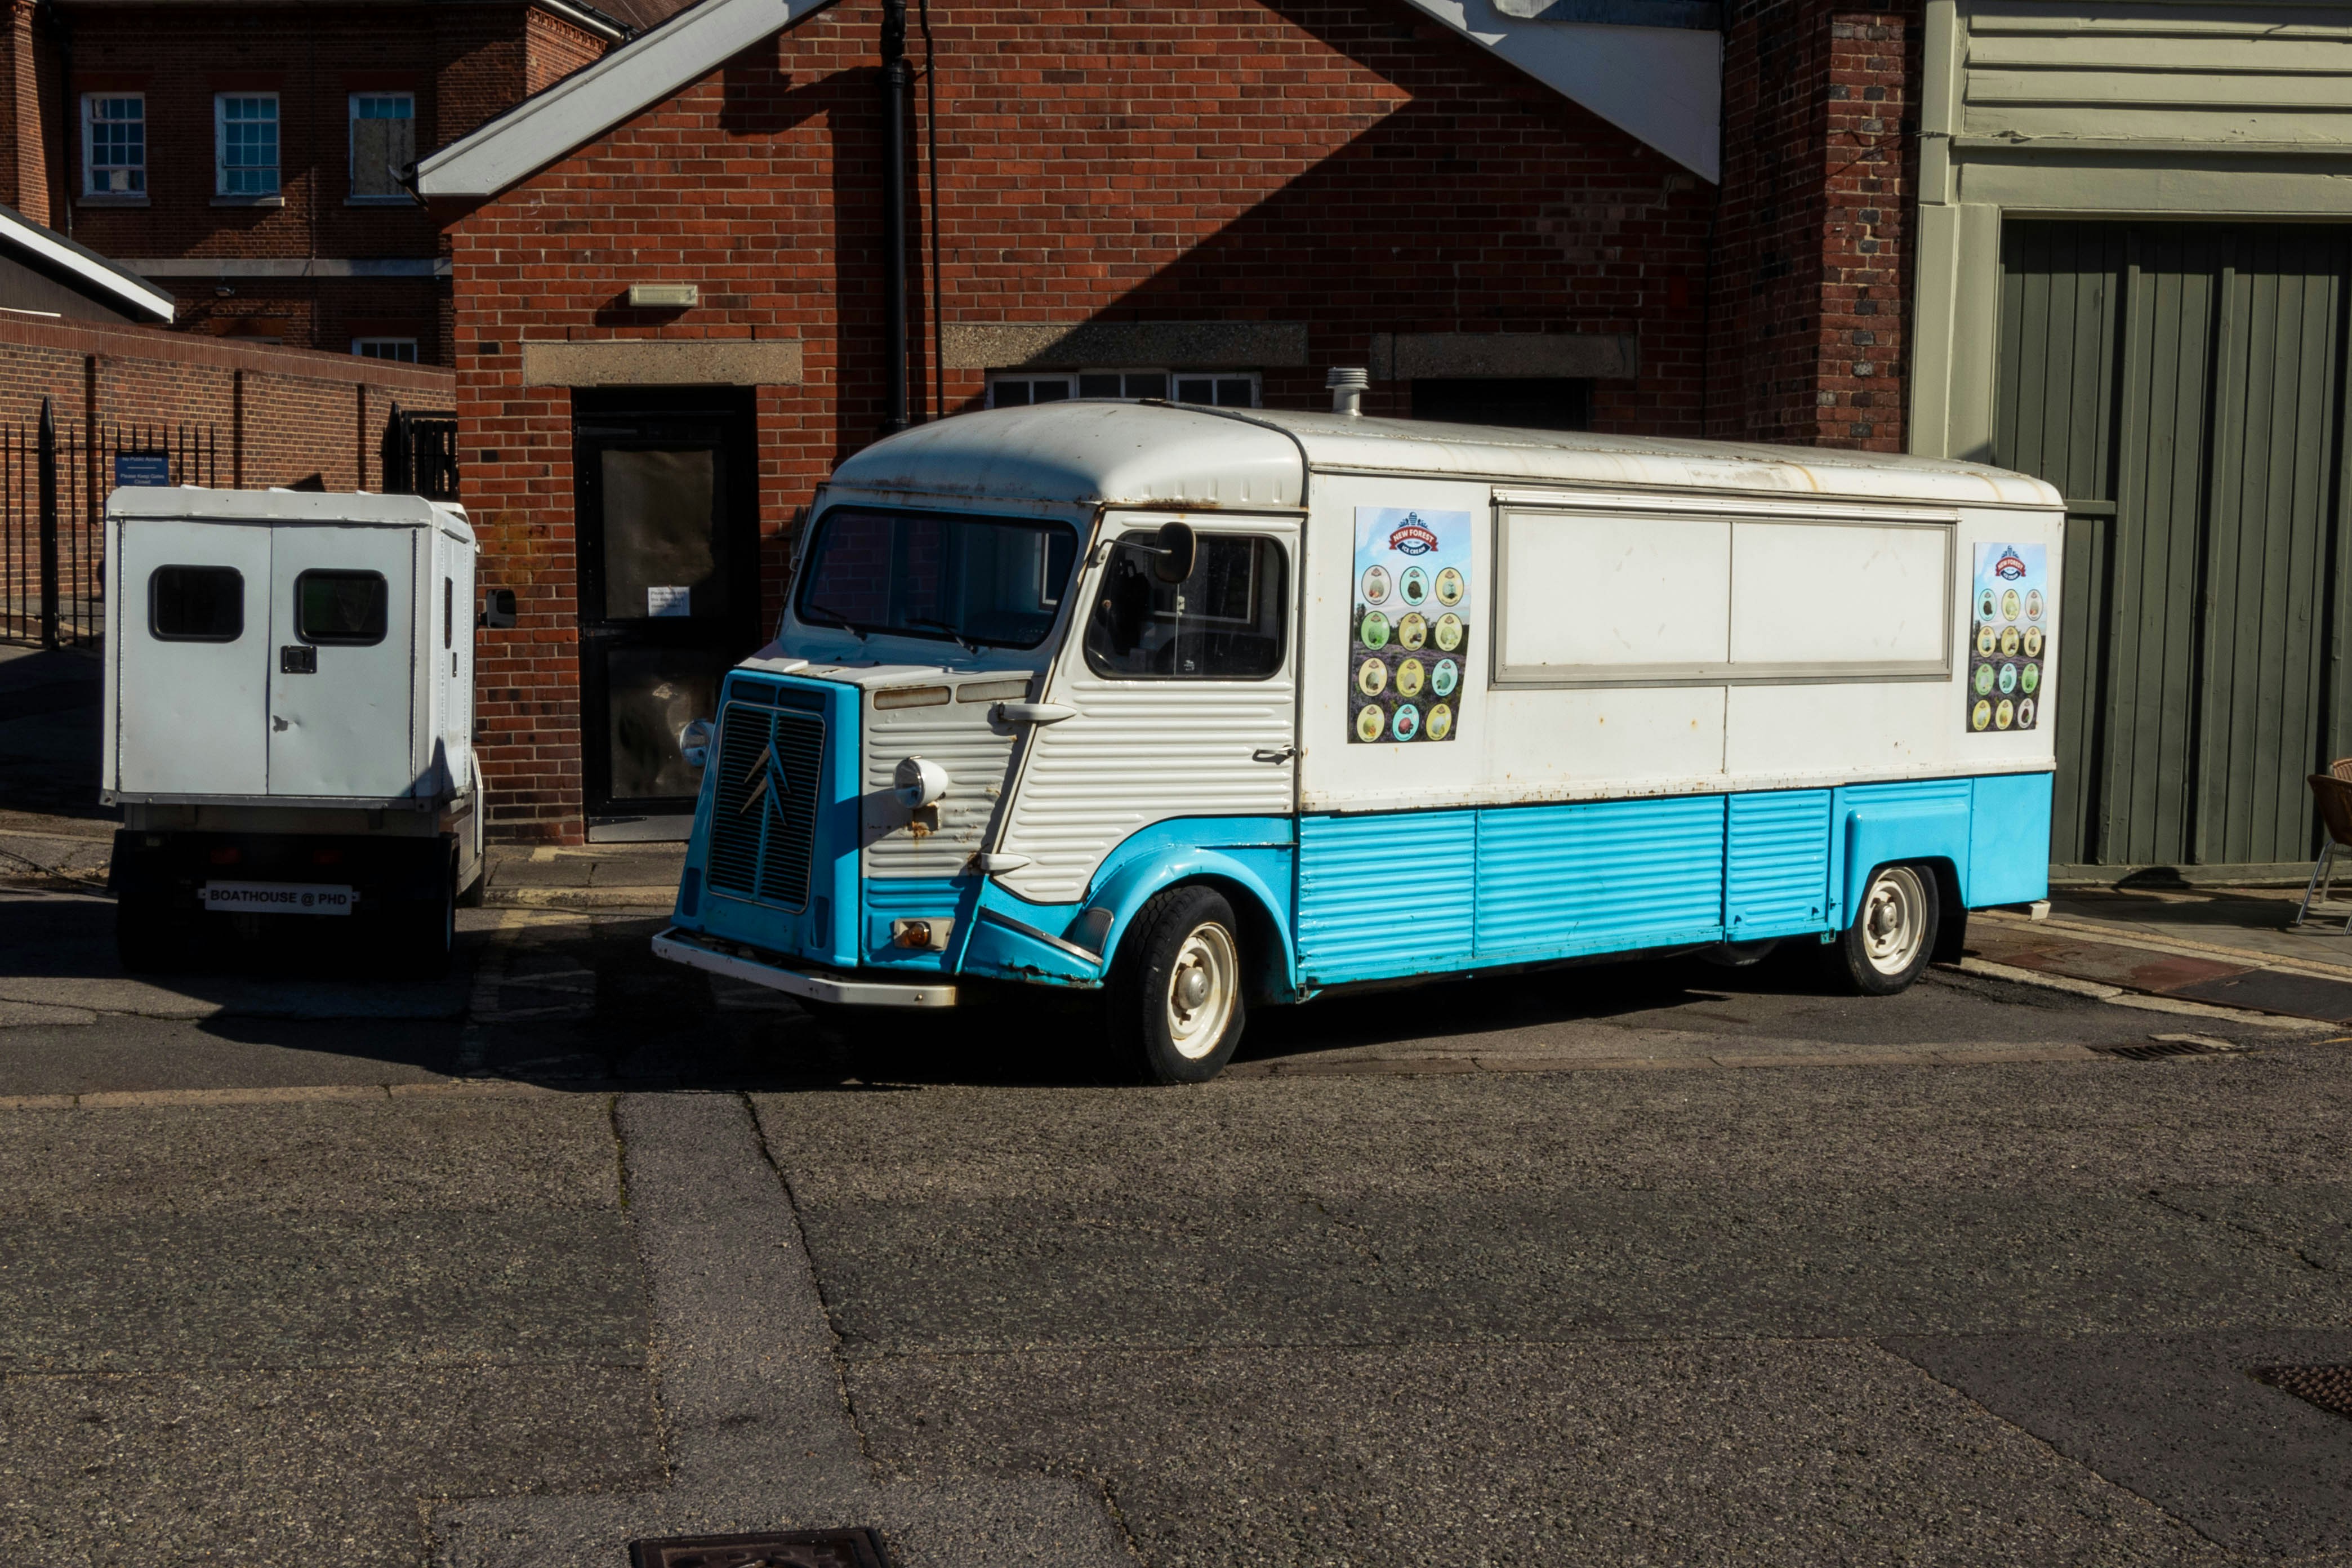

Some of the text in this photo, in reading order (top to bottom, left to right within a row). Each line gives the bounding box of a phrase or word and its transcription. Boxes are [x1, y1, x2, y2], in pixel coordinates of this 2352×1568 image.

[1393, 529, 1435, 542] NEW FOREST
[1401, 545, 1410, 553] ICE
[210, 889, 348, 906] BOATHOUSE @ PHD
